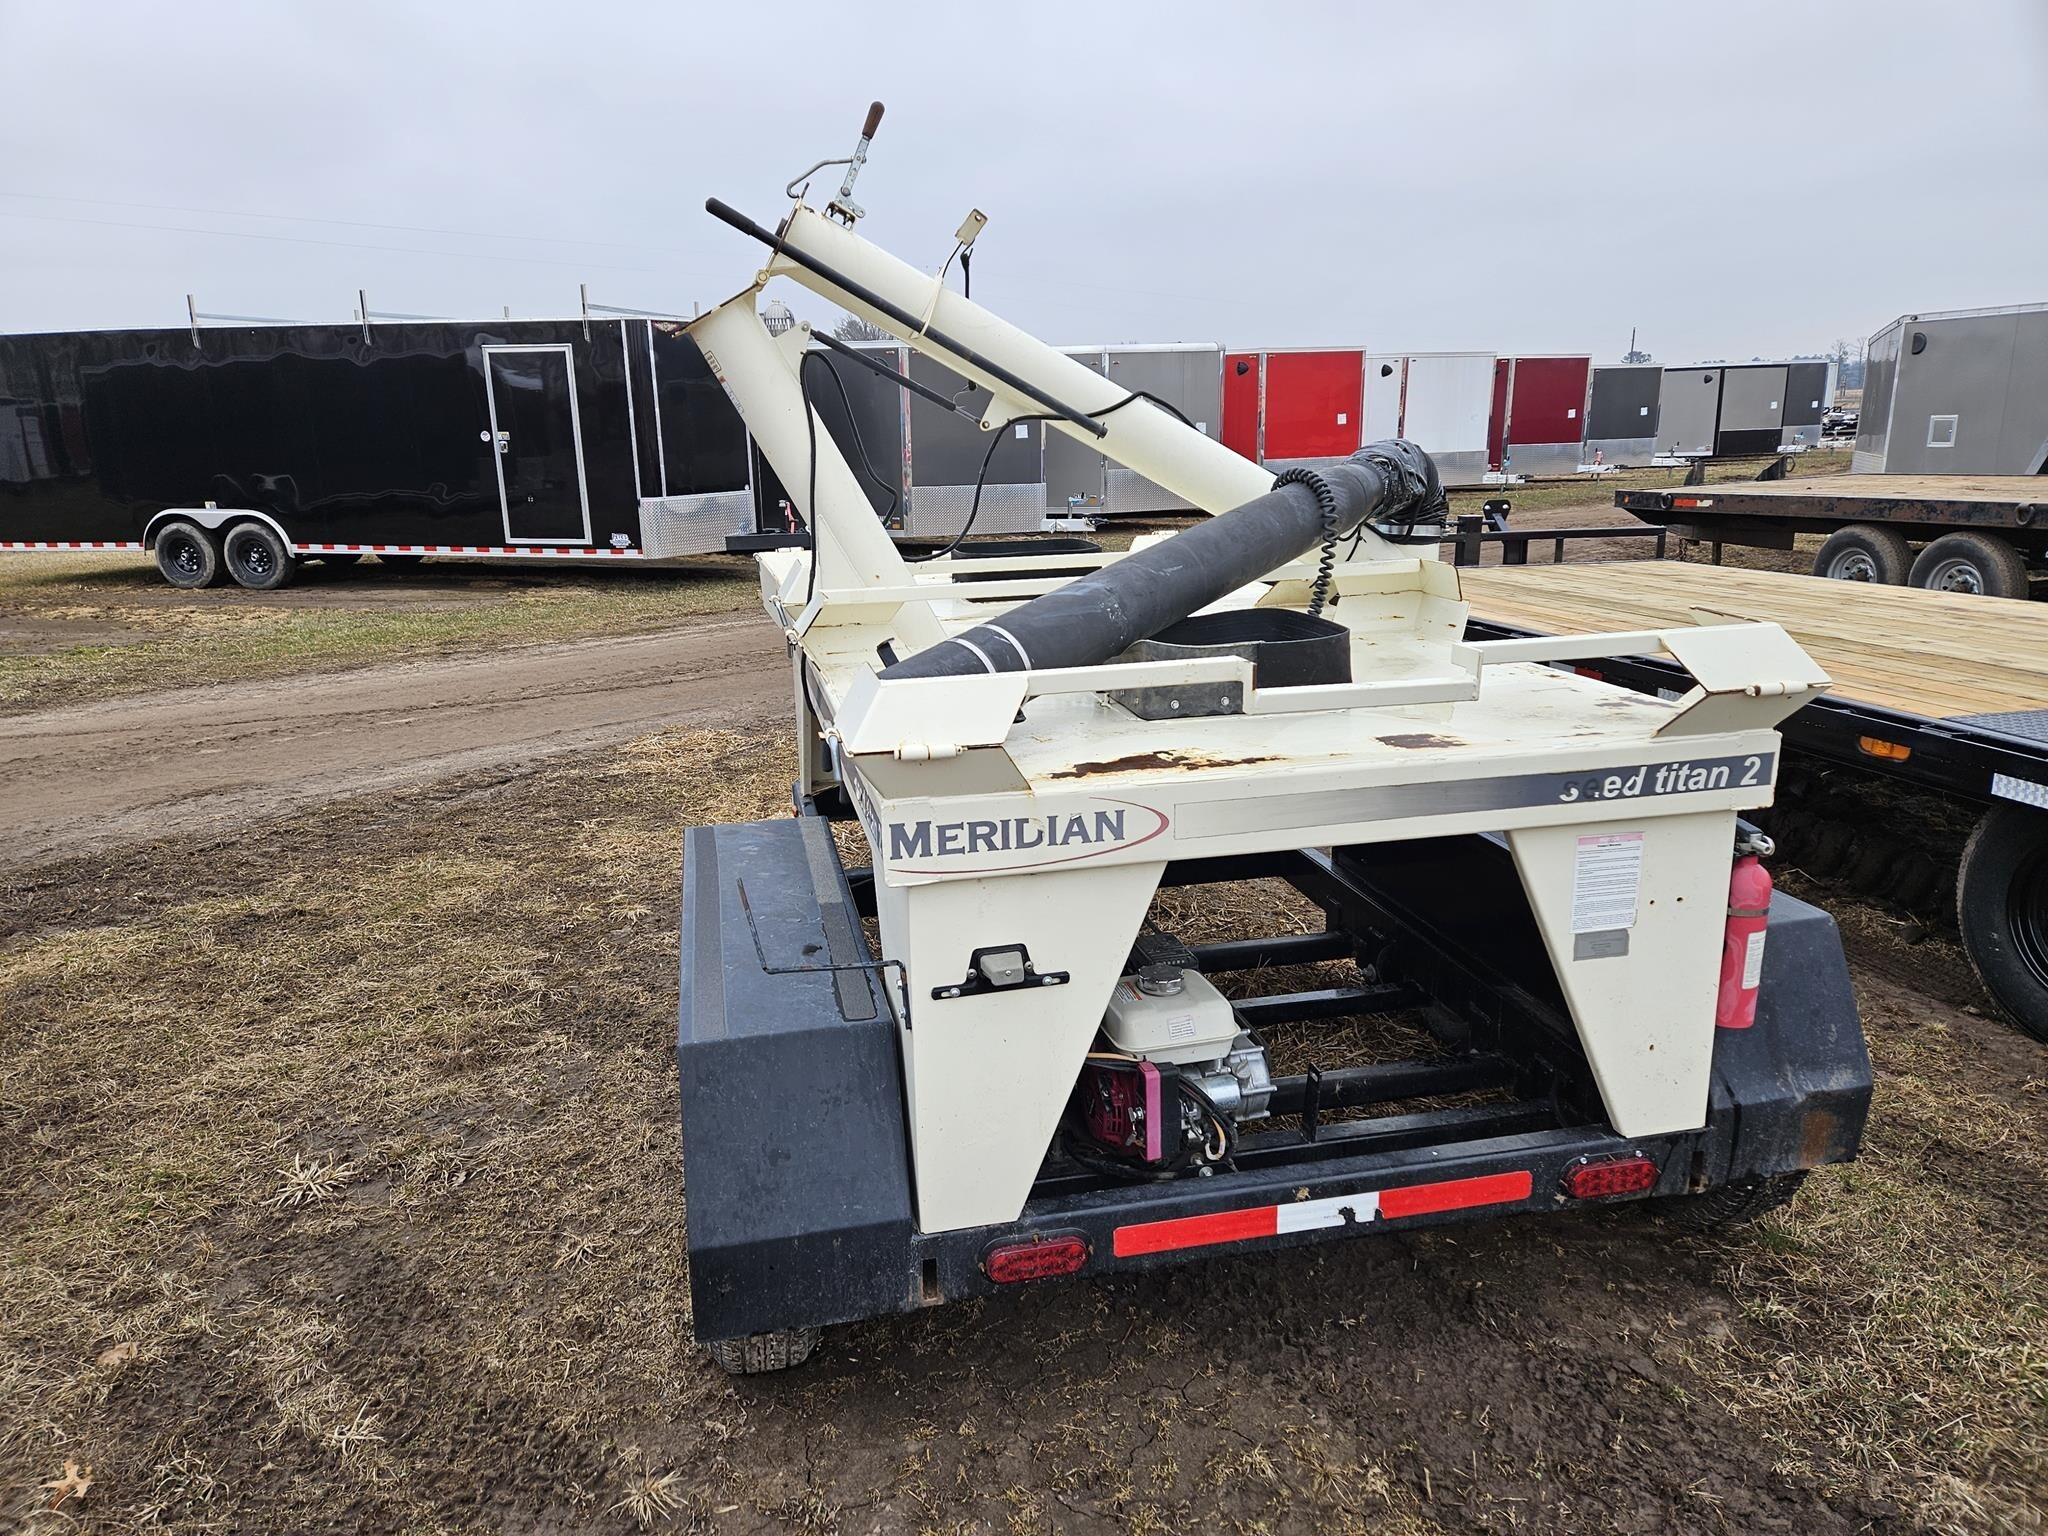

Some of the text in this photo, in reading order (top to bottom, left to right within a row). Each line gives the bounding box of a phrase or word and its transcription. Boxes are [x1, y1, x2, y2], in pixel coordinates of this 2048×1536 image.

[1655, 763, 1730, 793] titan
[1740, 756, 1762, 786] 2
[889, 809, 1126, 860] MERIDIAN
